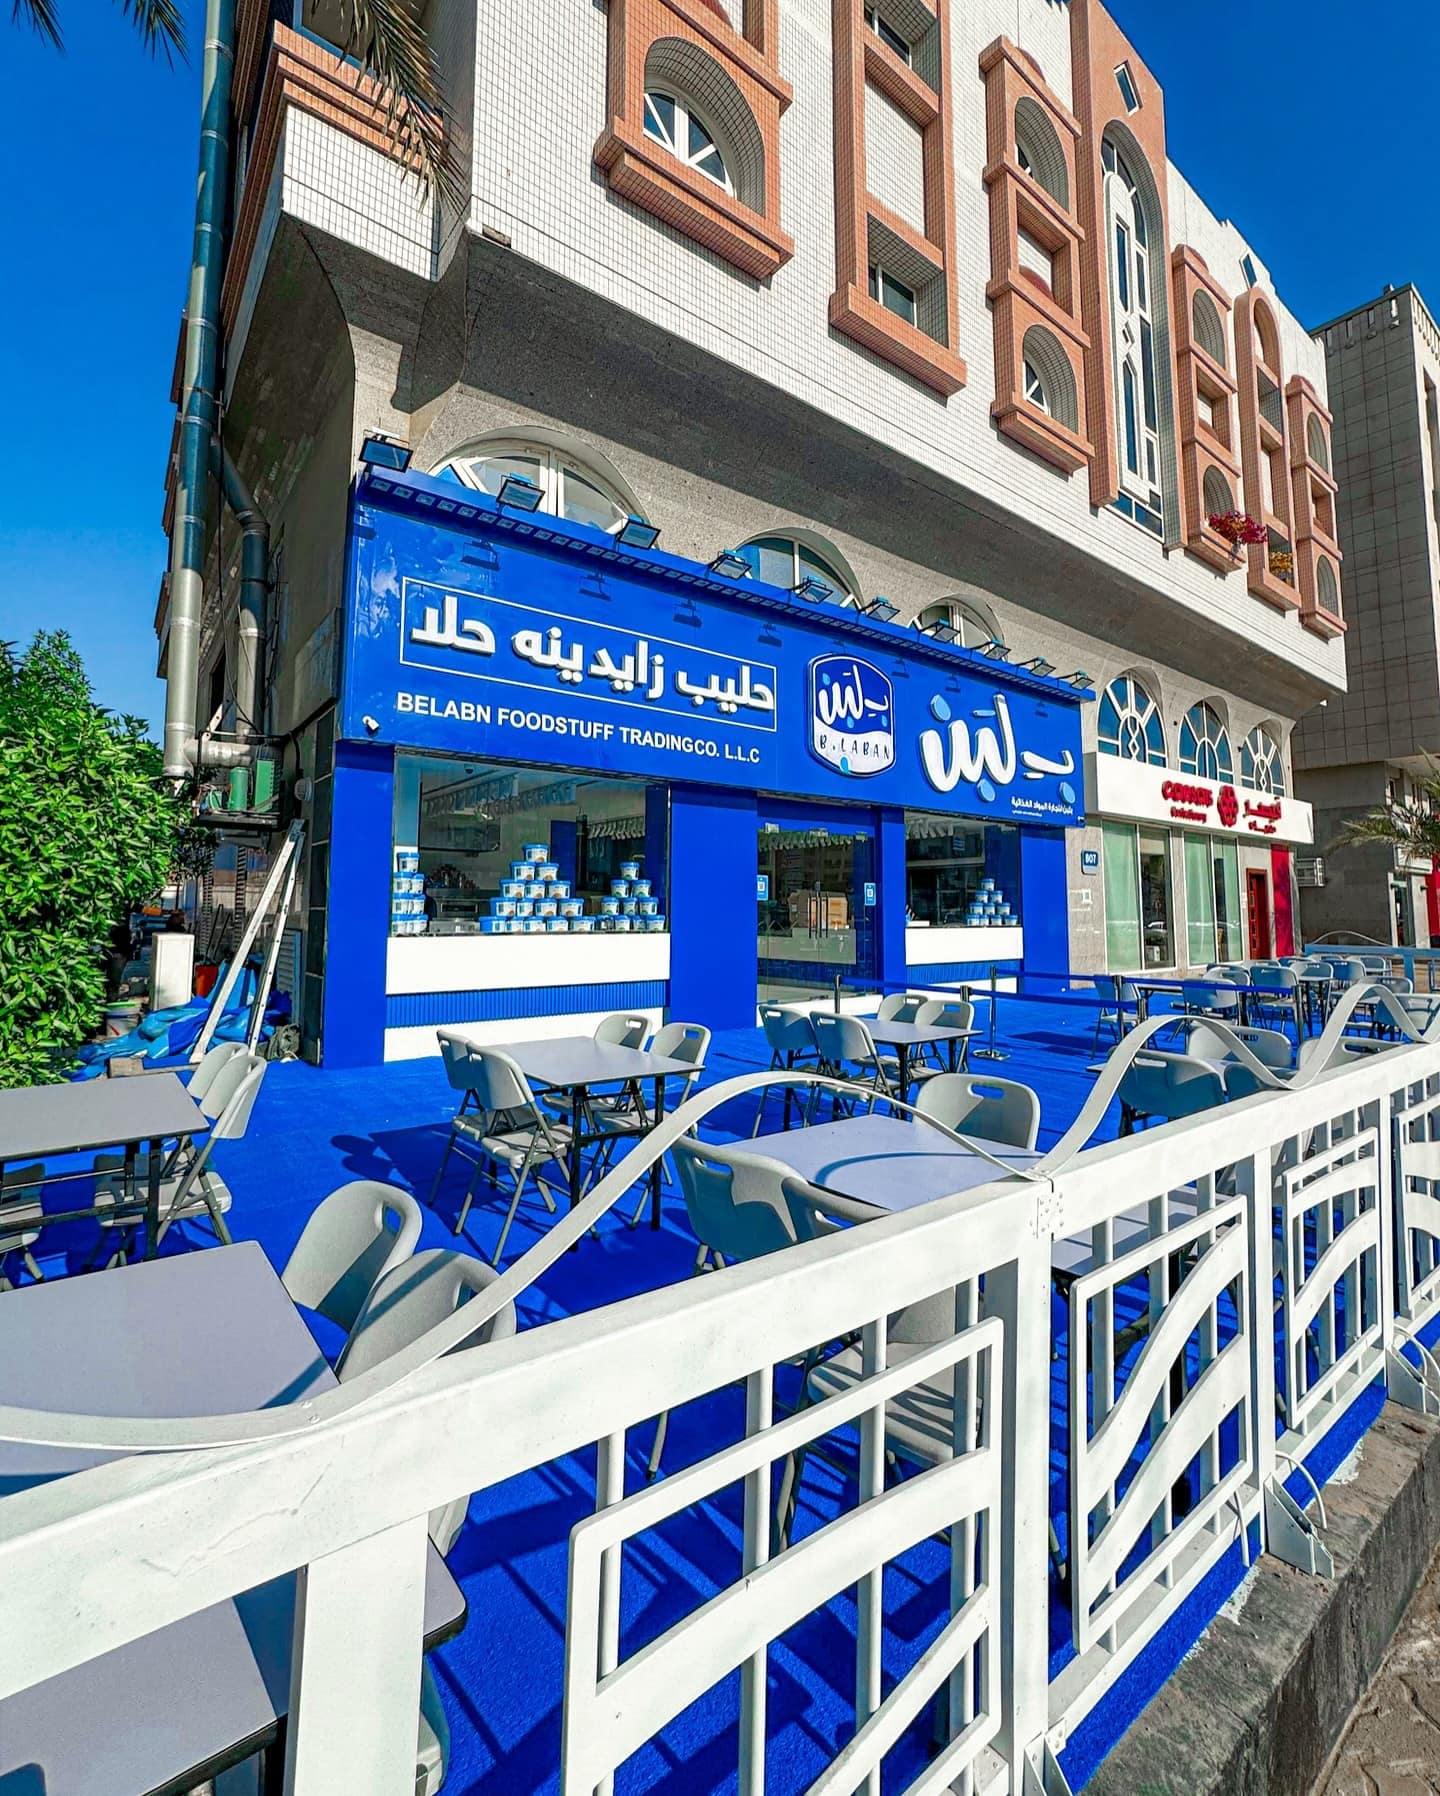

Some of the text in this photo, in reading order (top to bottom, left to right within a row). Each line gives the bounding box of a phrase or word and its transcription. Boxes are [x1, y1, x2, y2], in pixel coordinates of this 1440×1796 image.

[411, 594, 496, 656] حلا
[675, 665, 775, 713] حليب
[396, 691, 491, 724] BELABN
[498, 707, 615, 741] FOODSTUFF
[724, 743, 760, 764] L.L.C
